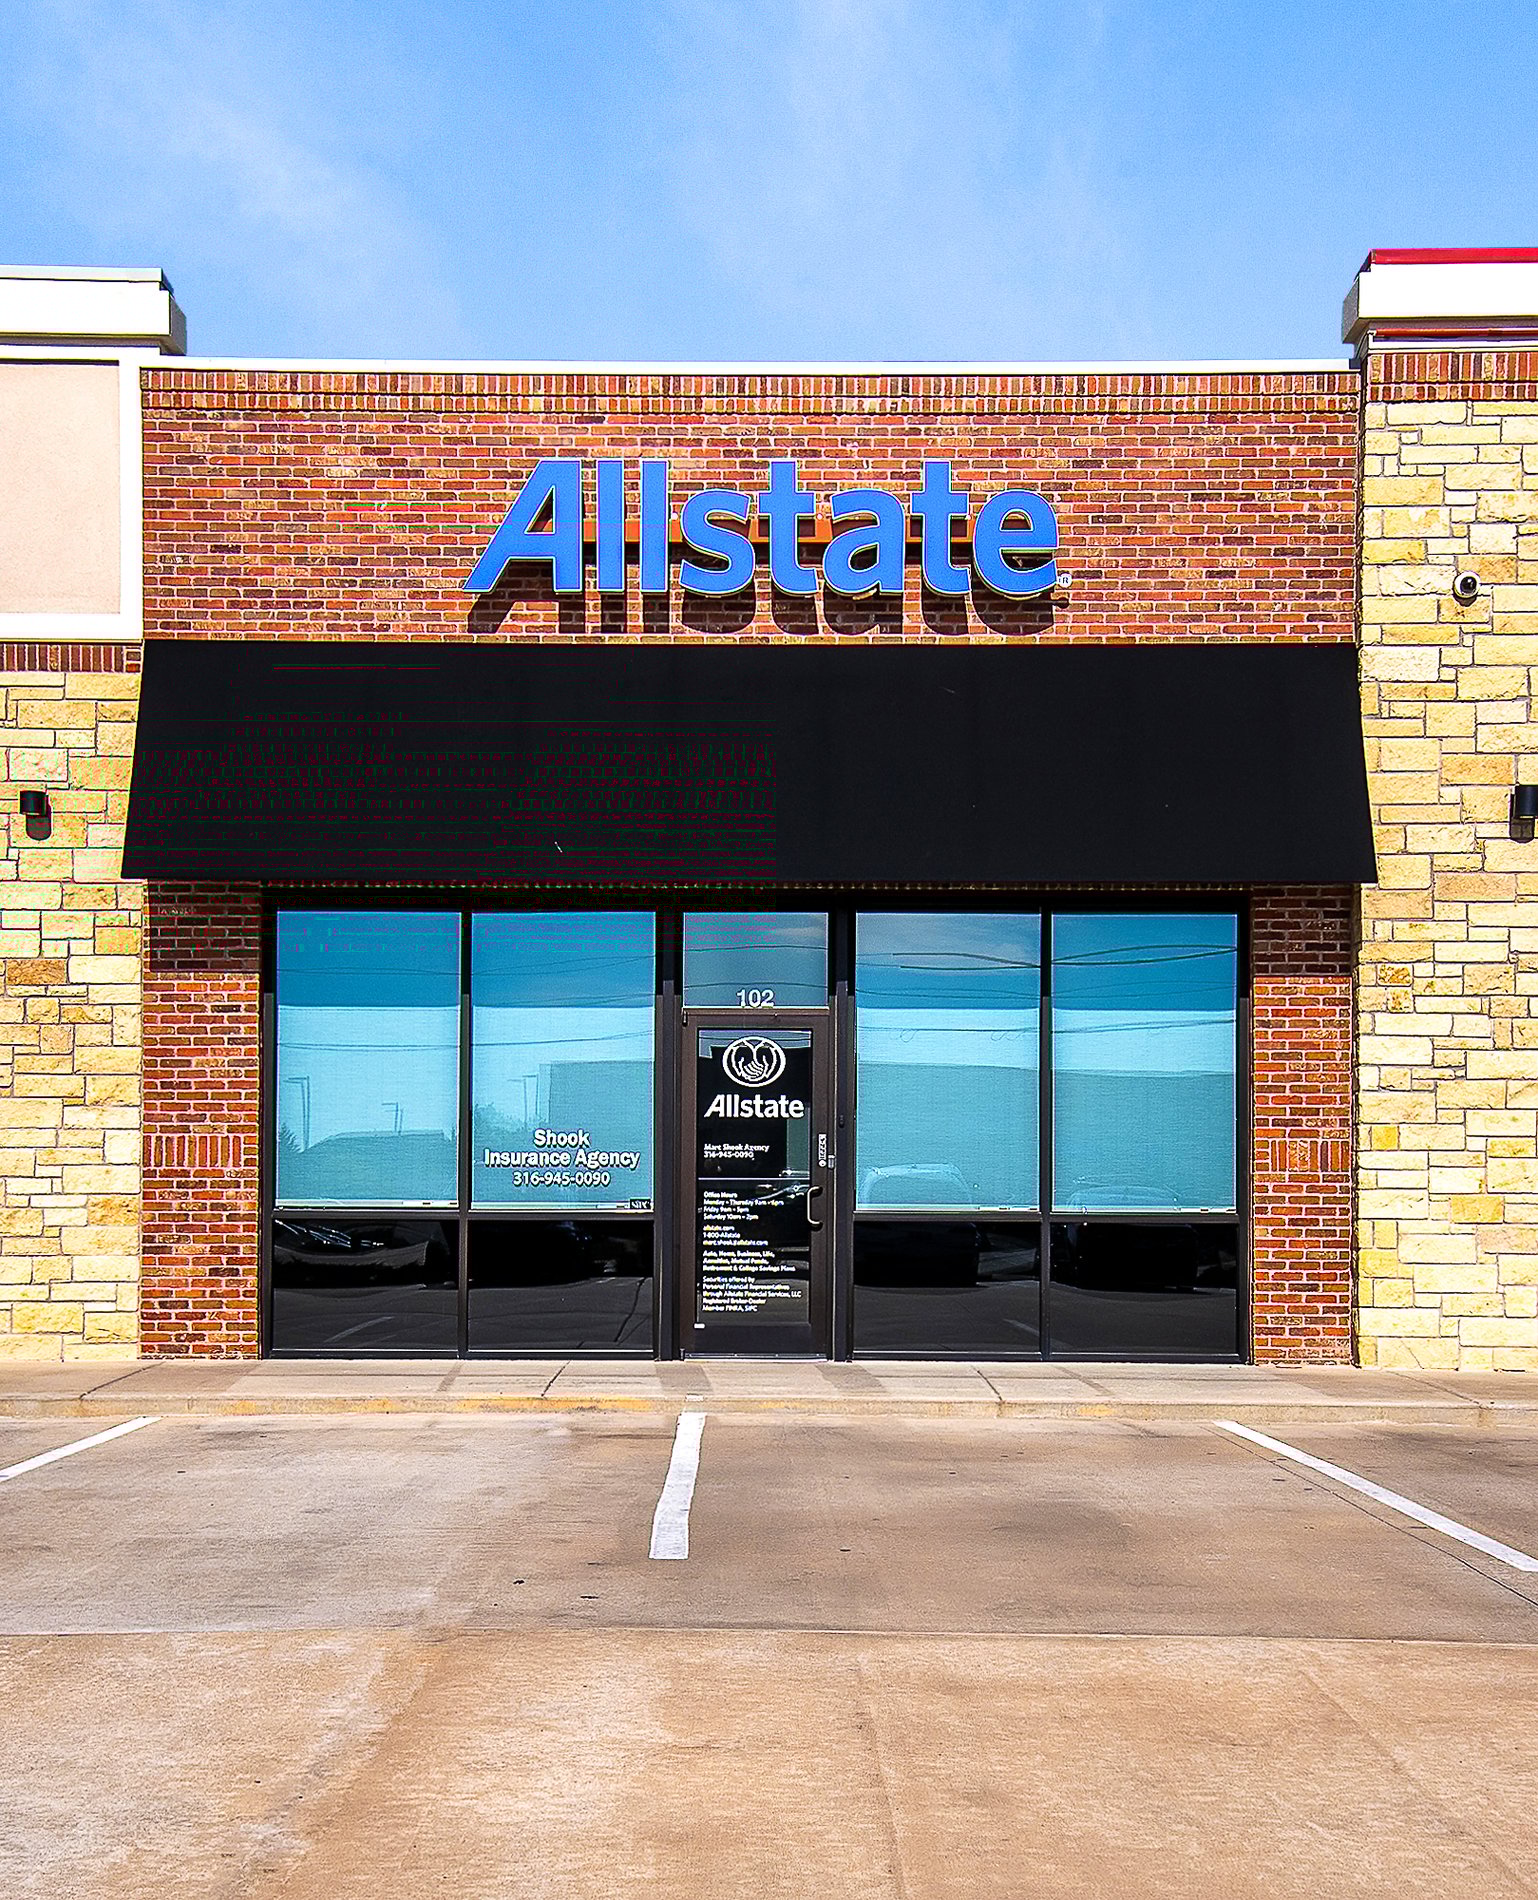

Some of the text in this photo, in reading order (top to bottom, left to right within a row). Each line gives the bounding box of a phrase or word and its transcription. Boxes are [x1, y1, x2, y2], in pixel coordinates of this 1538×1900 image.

[462, 458, 1059, 594] Allstate
[736, 989, 775, 1008] 102
[703, 1094, 805, 1119] Allstate
[533, 1129, 591, 1147] Shook
[484, 1149, 640, 1170] Insurance Agency
[513, 1171, 611, 1186] 316-945-0090
